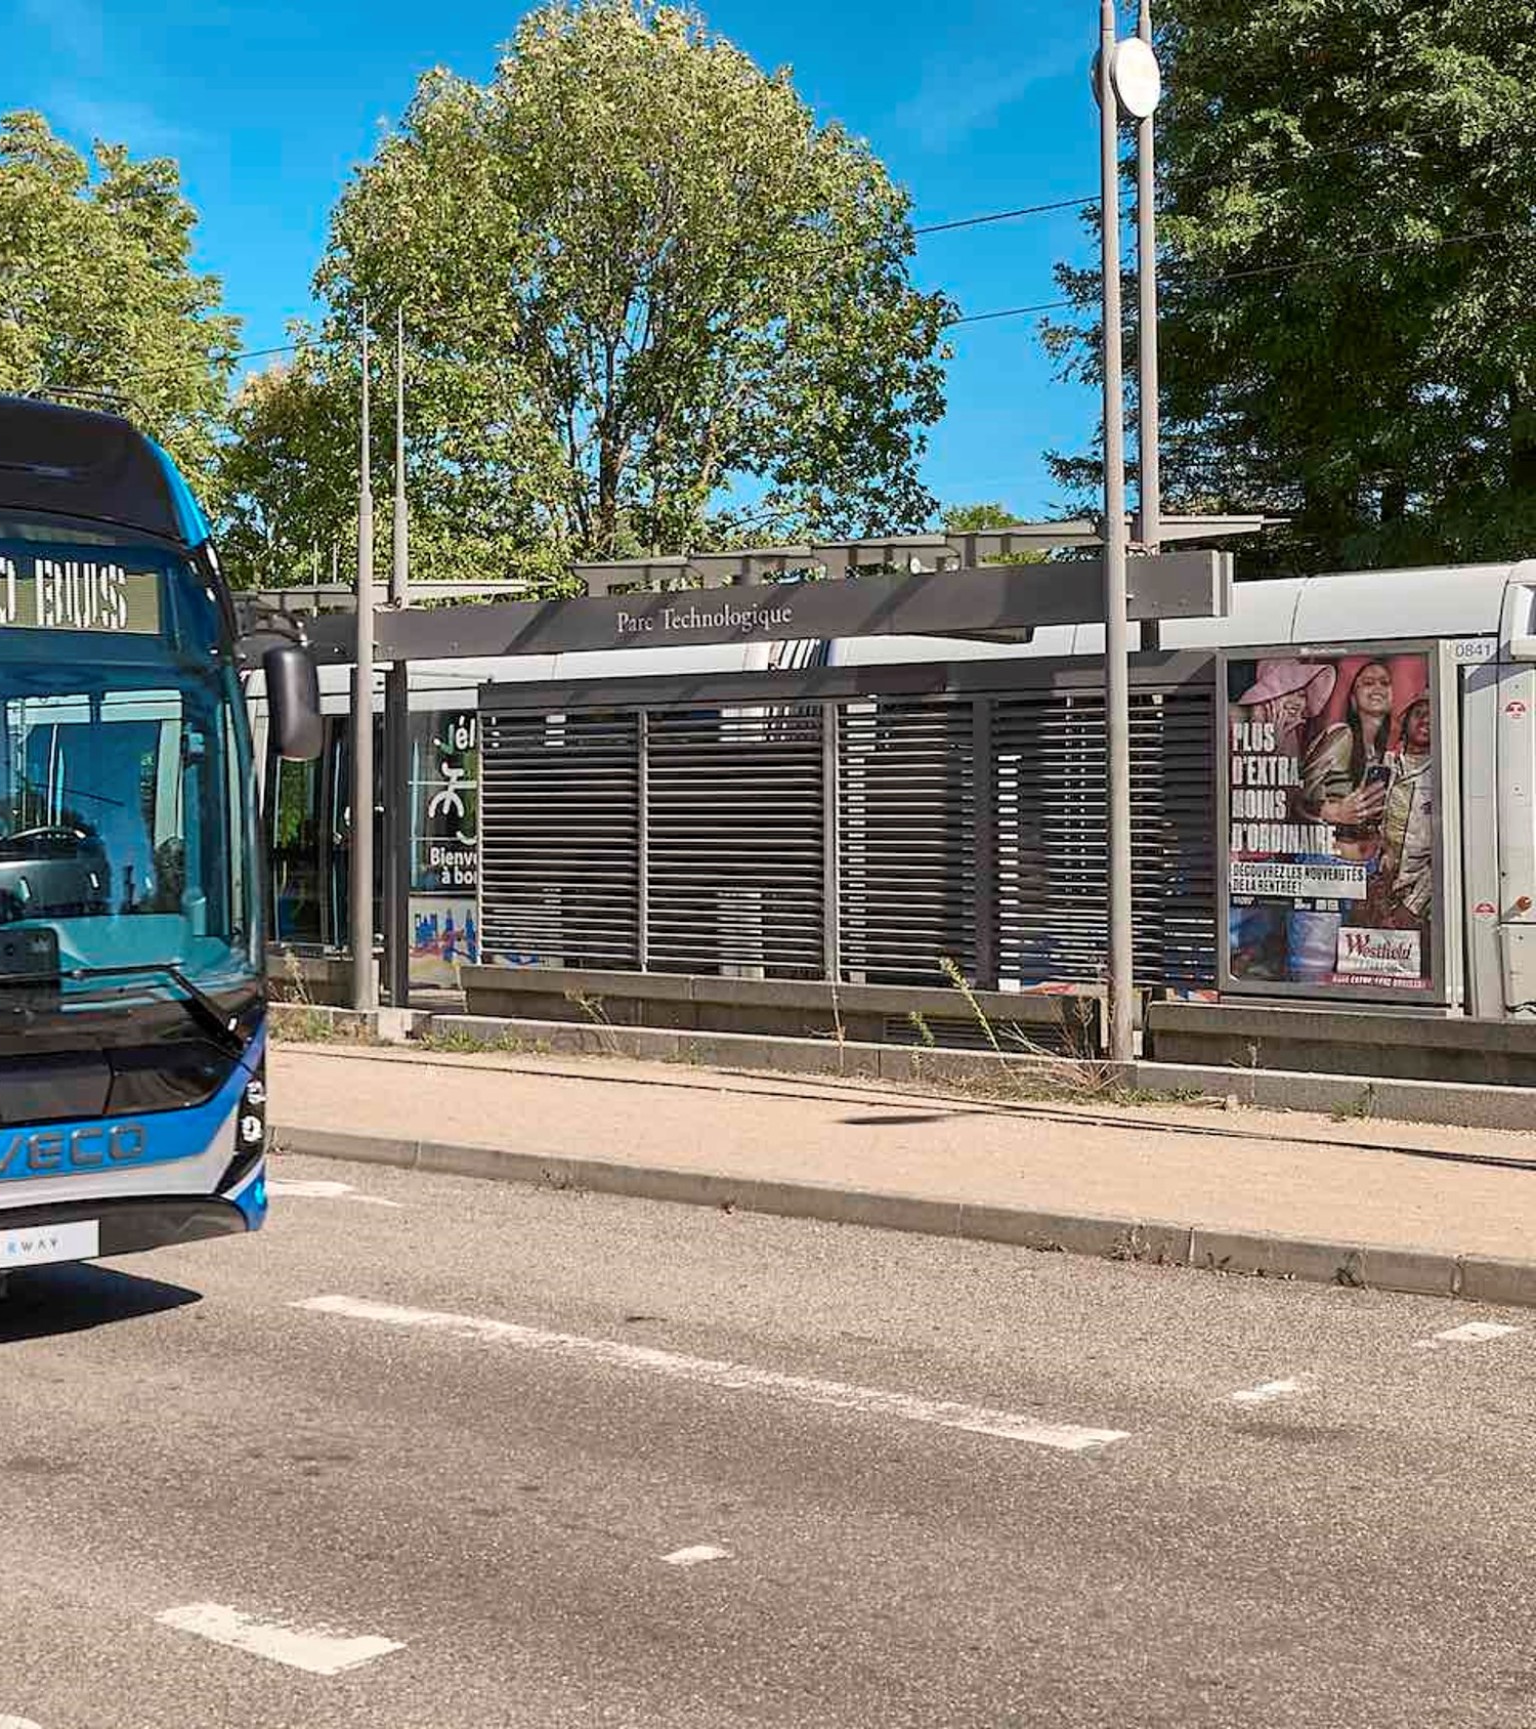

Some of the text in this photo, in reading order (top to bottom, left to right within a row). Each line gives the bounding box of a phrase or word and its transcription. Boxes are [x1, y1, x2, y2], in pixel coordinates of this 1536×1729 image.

[35, 558, 128, 630] BUS
[617, 603, 793, 633] Parc Technologique
[1456, 643, 1491, 658] 0841
[1232, 721, 1275, 752] PLUS
[1231, 789, 1287, 820] MOINS
[441, 865, 451, 885] à
[1345, 934, 1413, 961] Westfield
